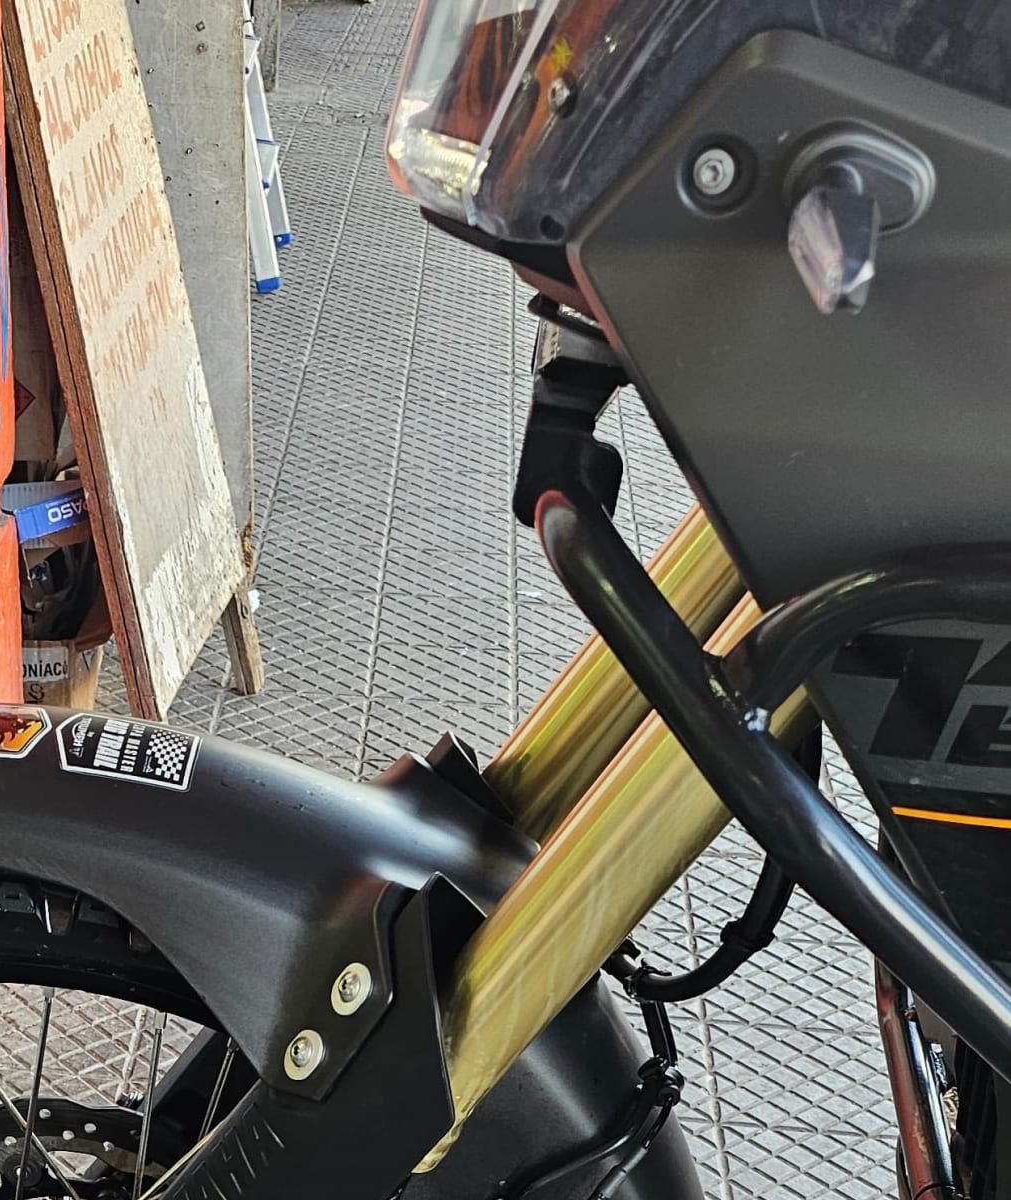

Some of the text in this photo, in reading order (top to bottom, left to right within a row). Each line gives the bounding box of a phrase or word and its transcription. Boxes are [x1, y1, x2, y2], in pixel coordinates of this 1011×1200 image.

[43, 30, 122, 155] ALCOHOL
[59, 123, 124, 243] CLAVOS
[93, 732, 125, 769] TRAIL
[119, 738, 141, 773] MASTER
